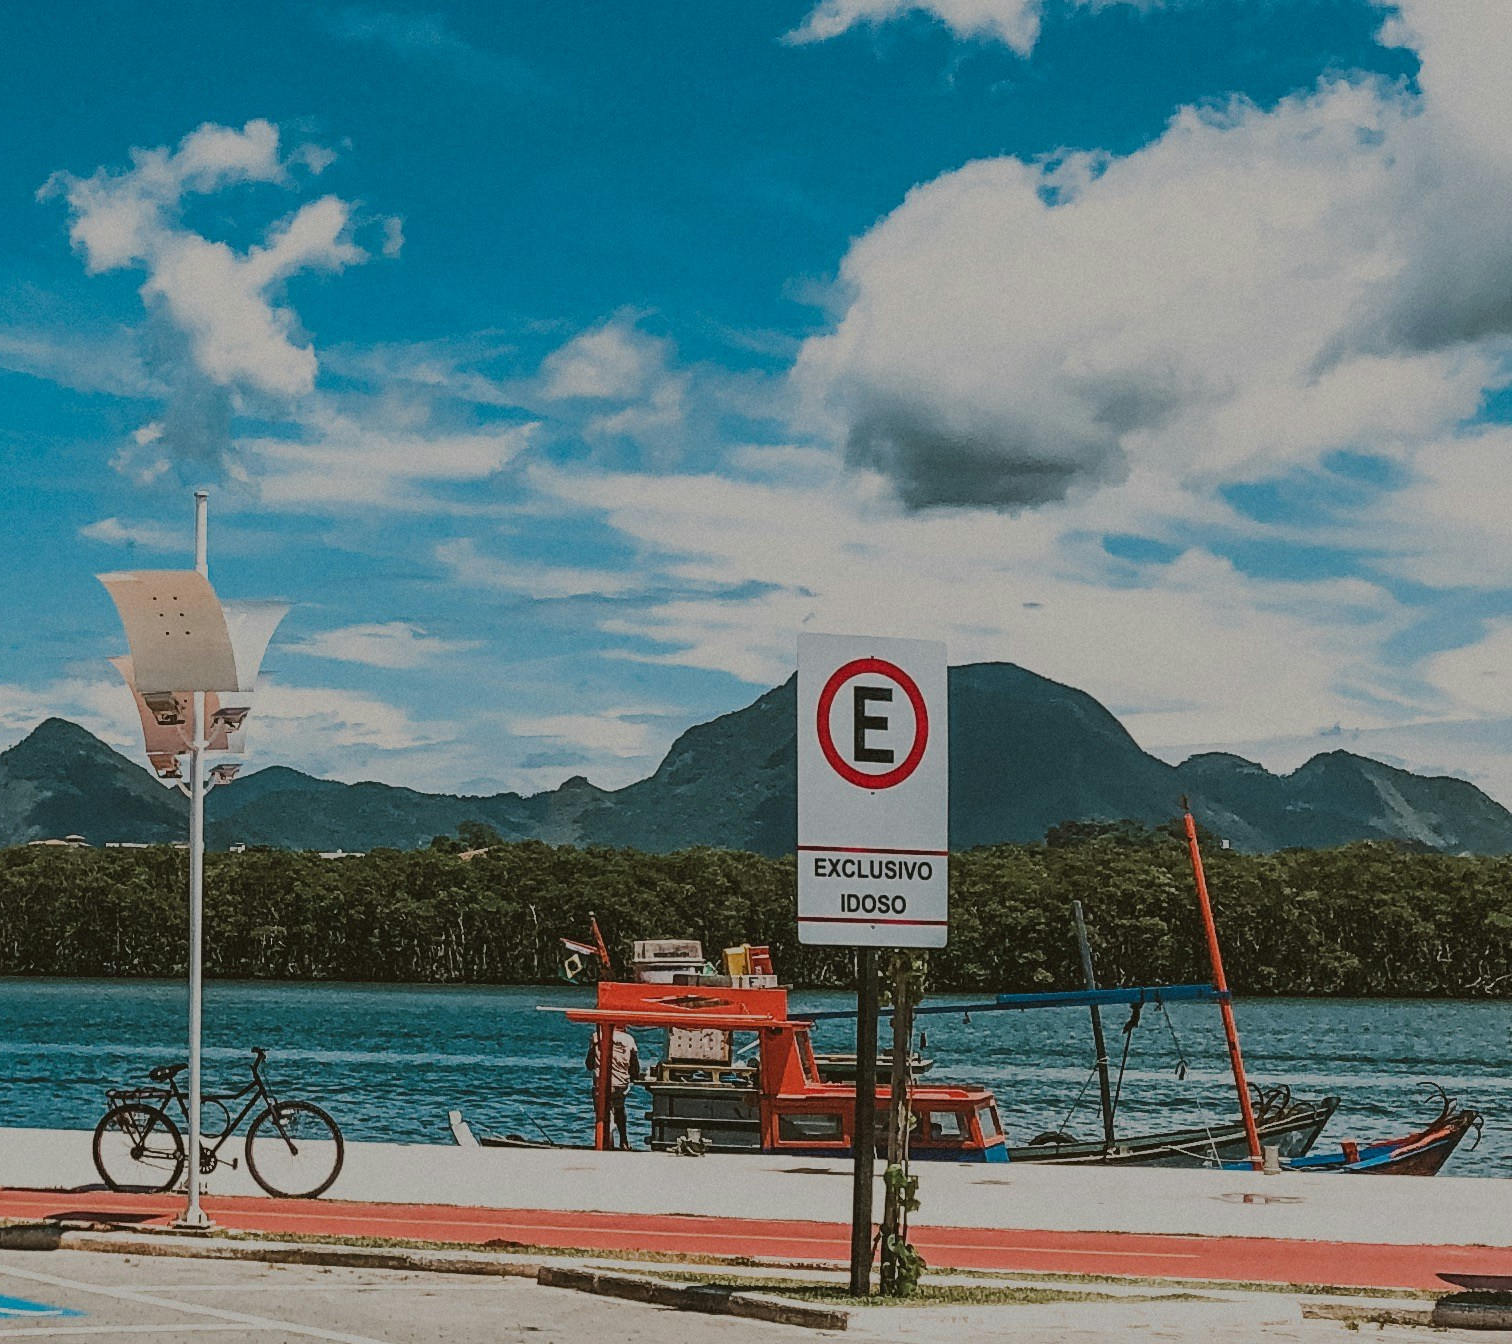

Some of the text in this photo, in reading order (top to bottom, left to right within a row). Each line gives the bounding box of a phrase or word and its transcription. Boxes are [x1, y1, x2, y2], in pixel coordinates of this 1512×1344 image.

[853, 686, 895, 764] E
[814, 857, 934, 881] EXCLUSIVO
[840, 893, 907, 914] IDOSO
